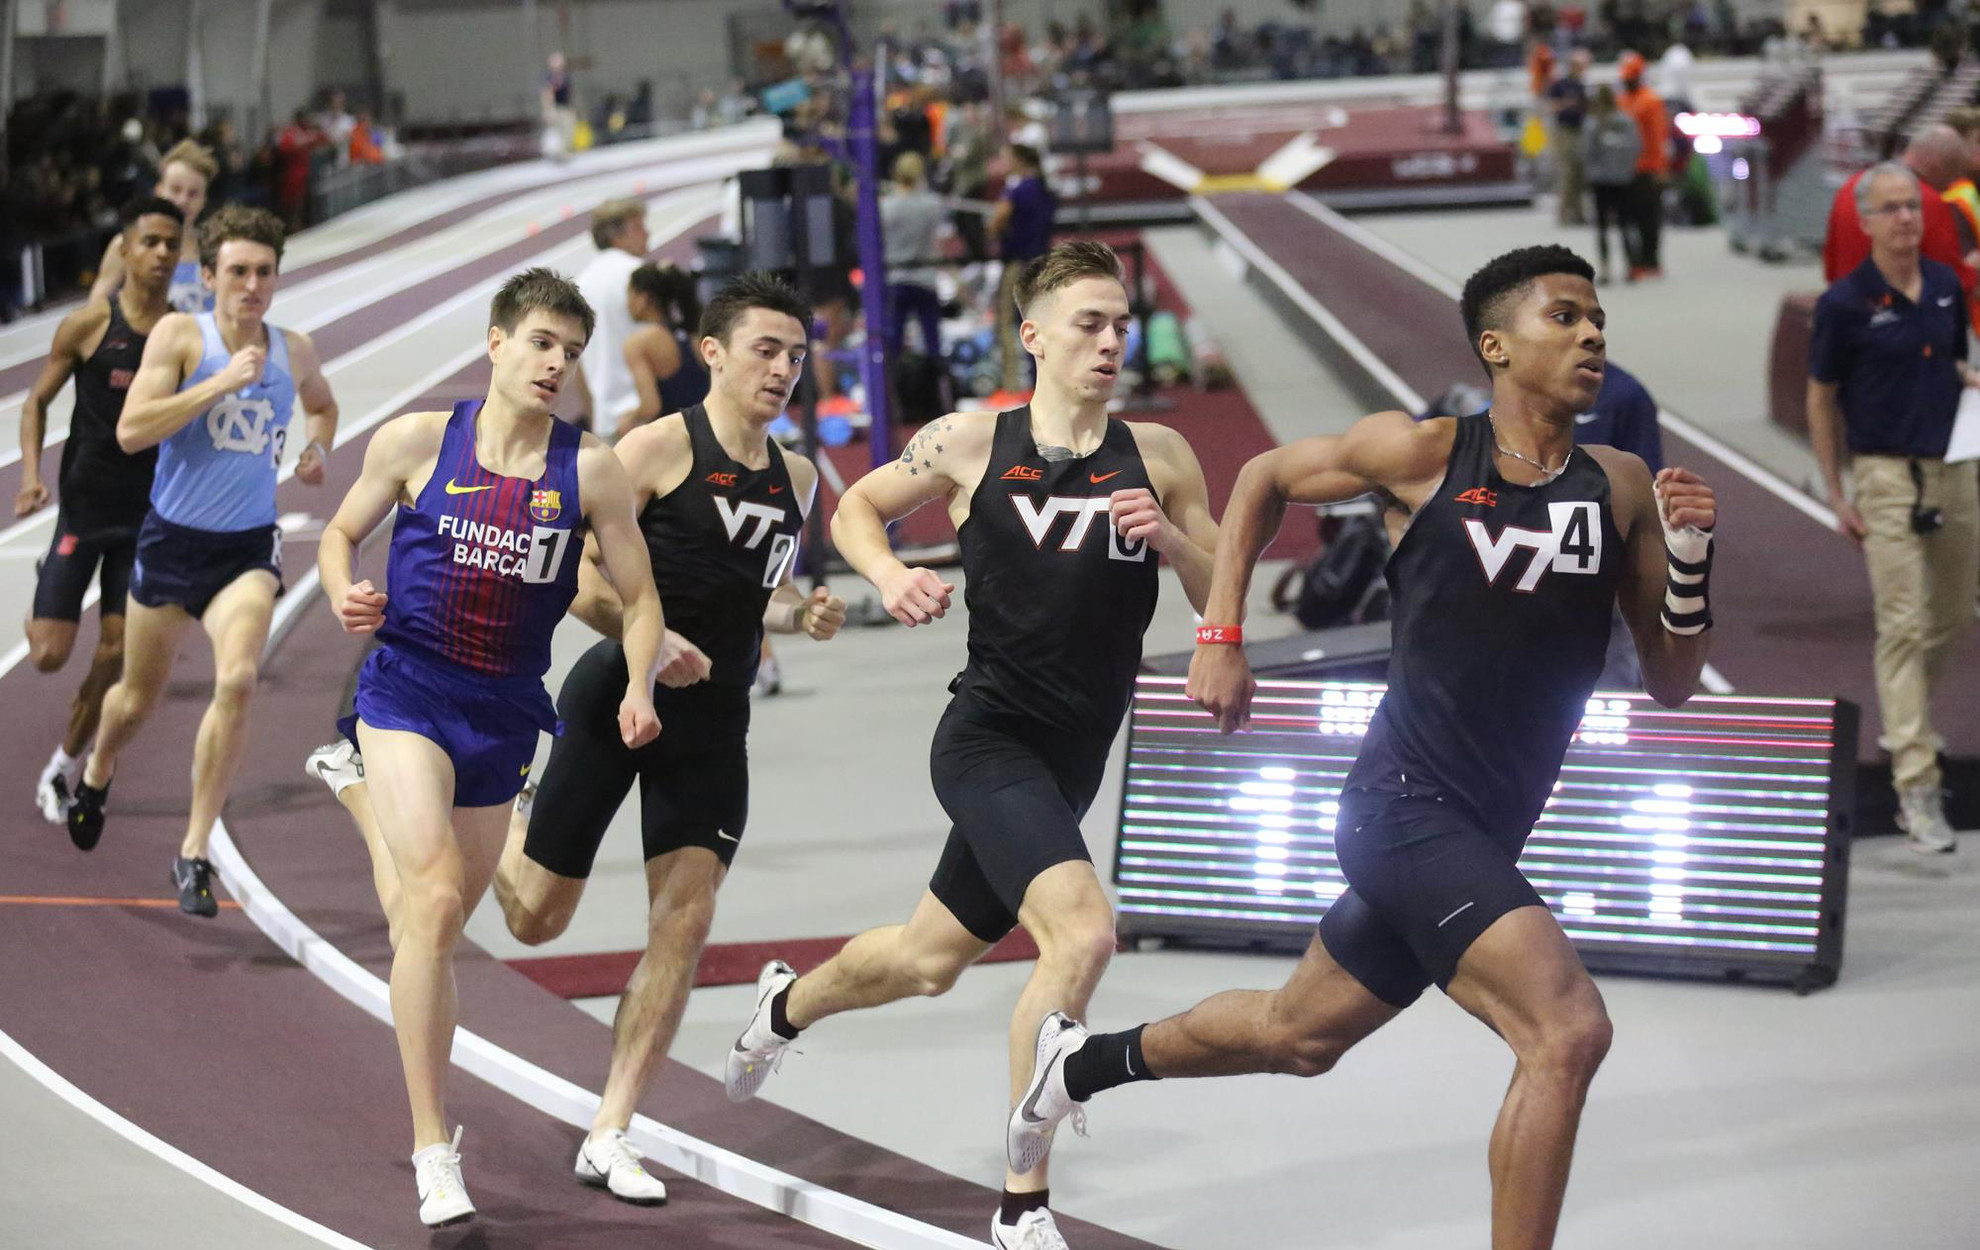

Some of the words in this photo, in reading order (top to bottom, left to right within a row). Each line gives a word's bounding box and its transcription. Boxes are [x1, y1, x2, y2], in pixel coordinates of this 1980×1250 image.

[705, 472, 738, 487] ACC
[999, 465, 1044, 481] ACC
[1454, 487, 1498, 507] ACC
[711, 493, 786, 550] VT
[1008, 493, 1112, 552] VT
[1560, 506, 1595, 569] 4
[453, 543, 528, 578] BARÇA
[538, 532, 560, 579] 1
[1461, 517, 1554, 593] VT
